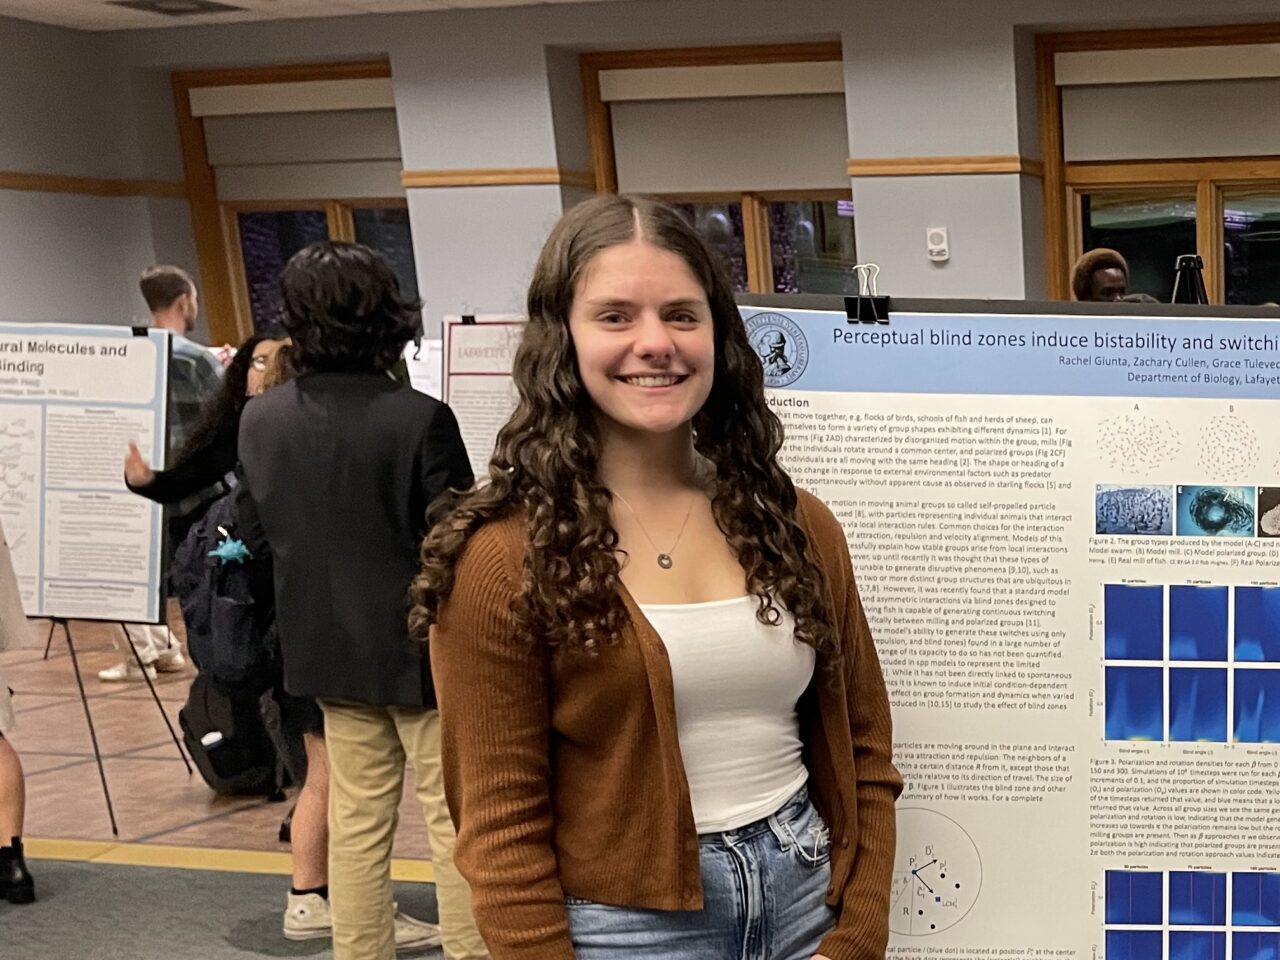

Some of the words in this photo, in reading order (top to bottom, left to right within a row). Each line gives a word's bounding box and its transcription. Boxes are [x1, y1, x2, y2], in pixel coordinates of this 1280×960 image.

[833, 325, 923, 350] Perceptual
[930, 327, 971, 346] blind
[978, 333, 1025, 346] zones
[1032, 328, 1088, 347] induce
[1094, 329, 1176, 354] bistability
[1182, 331, 1213, 349] and
[28, 341, 96, 355] Molecules
[100, 345, 127, 357] and
[0, 360, 44, 376] inding
[1058, 355, 1091, 366] Rachel
[1094, 355, 1130, 370] Giunta,
[1133, 356, 1172, 370] Zachary
[1175, 356, 1209, 371] Cullen,
[1212, 357, 1241, 368] Grace
[1127, 371, 1187, 386] Department
[1190, 372, 1201, 383] of
[1204, 372, 1242, 387] Biology,
[846, 531, 855, 539] of
[894, 532, 927, 543] repulsion
[928, 532, 942, 540] and
[944, 532, 971, 543] velocity
[1012, 533, 1038, 542] Models
[1040, 534, 1048, 542] of
[1048, 534, 1062, 542] this
